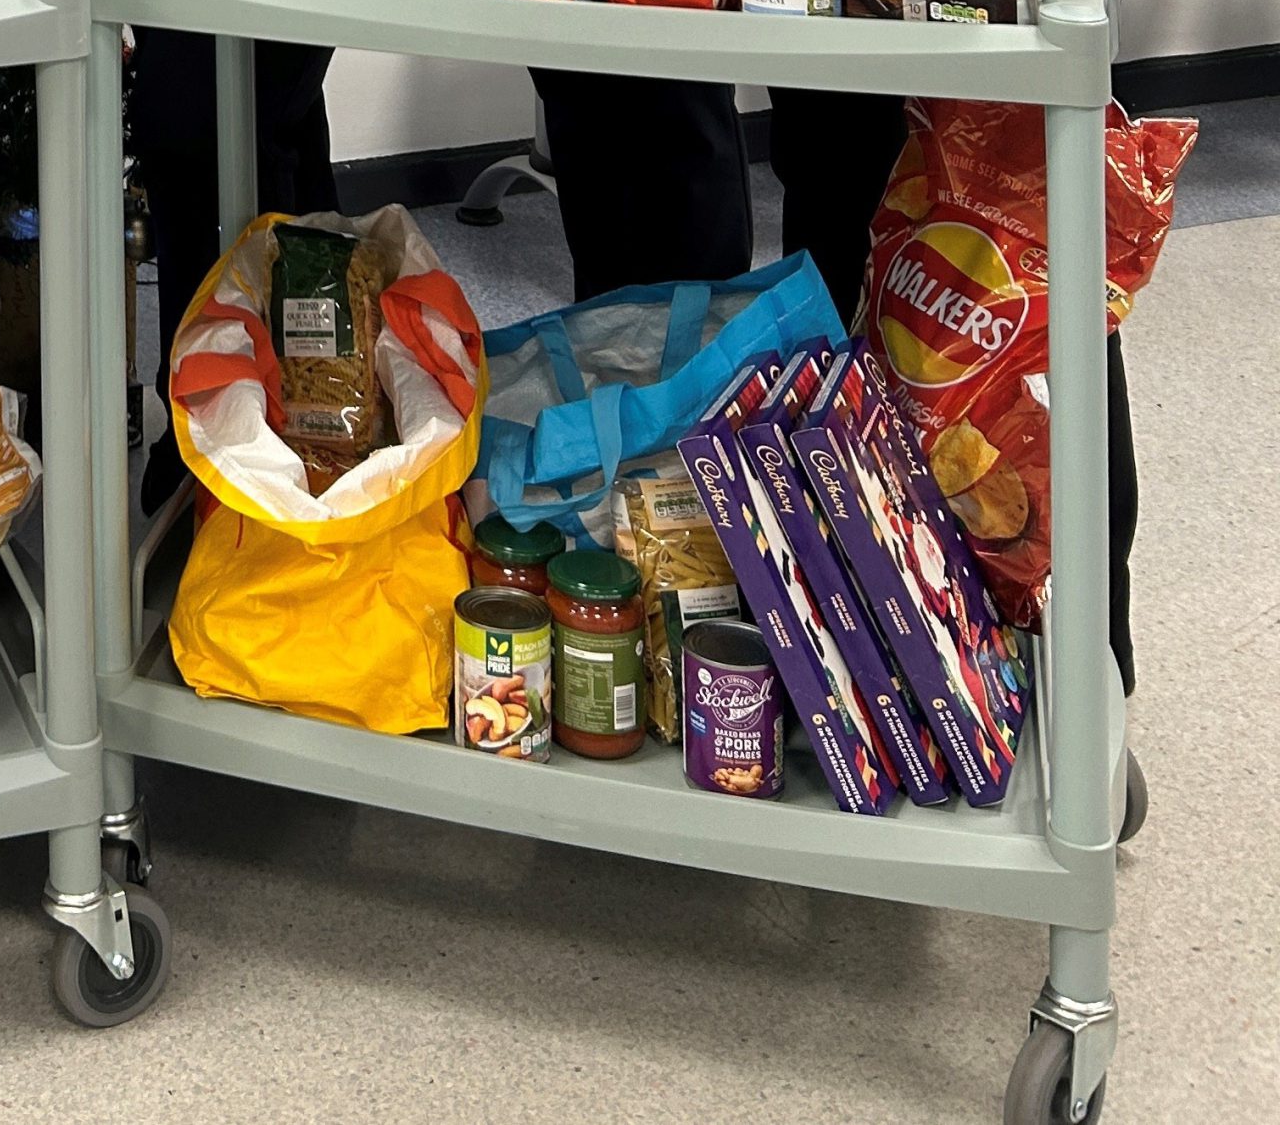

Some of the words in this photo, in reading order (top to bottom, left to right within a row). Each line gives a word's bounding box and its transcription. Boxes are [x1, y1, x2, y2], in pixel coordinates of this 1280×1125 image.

[908, 3, 921, 15] 10
[937, 188, 952, 203] WE
[952, 192, 973, 210] SEE
[884, 253, 1014, 353] WALKERS
[694, 456, 734, 529] Cadbury
[756, 444, 796, 514] Cadbury
[809, 449, 850, 519] Cadbury
[487, 660, 511, 674] PRIDE
[695, 675, 774, 707] Stockwell
[877, 694, 892, 707] 6
[812, 713, 827, 725] 6
[824, 725, 835, 737] OF
[714, 735, 724, 746] &
[724, 737, 761, 751] PORK
[714, 747, 762, 760] SAUSAGES
[828, 736, 843, 760] YOUR
[881, 708, 891, 717] IN
[886, 717, 898, 735] THIS
[894, 734, 919, 779] SELECTION
[913, 776, 926, 793] BOX
[889, 706, 899, 718] OF
[894, 717, 909, 739] YOUR
[904, 736, 930, 784] FAVOURITES
[816, 727, 826, 735] IN
[821, 734, 833, 755] THIS
[828, 754, 852, 800] SELECTION
[847, 797, 860, 814] BOX
[838, 758, 864, 806] FAVOURITES
